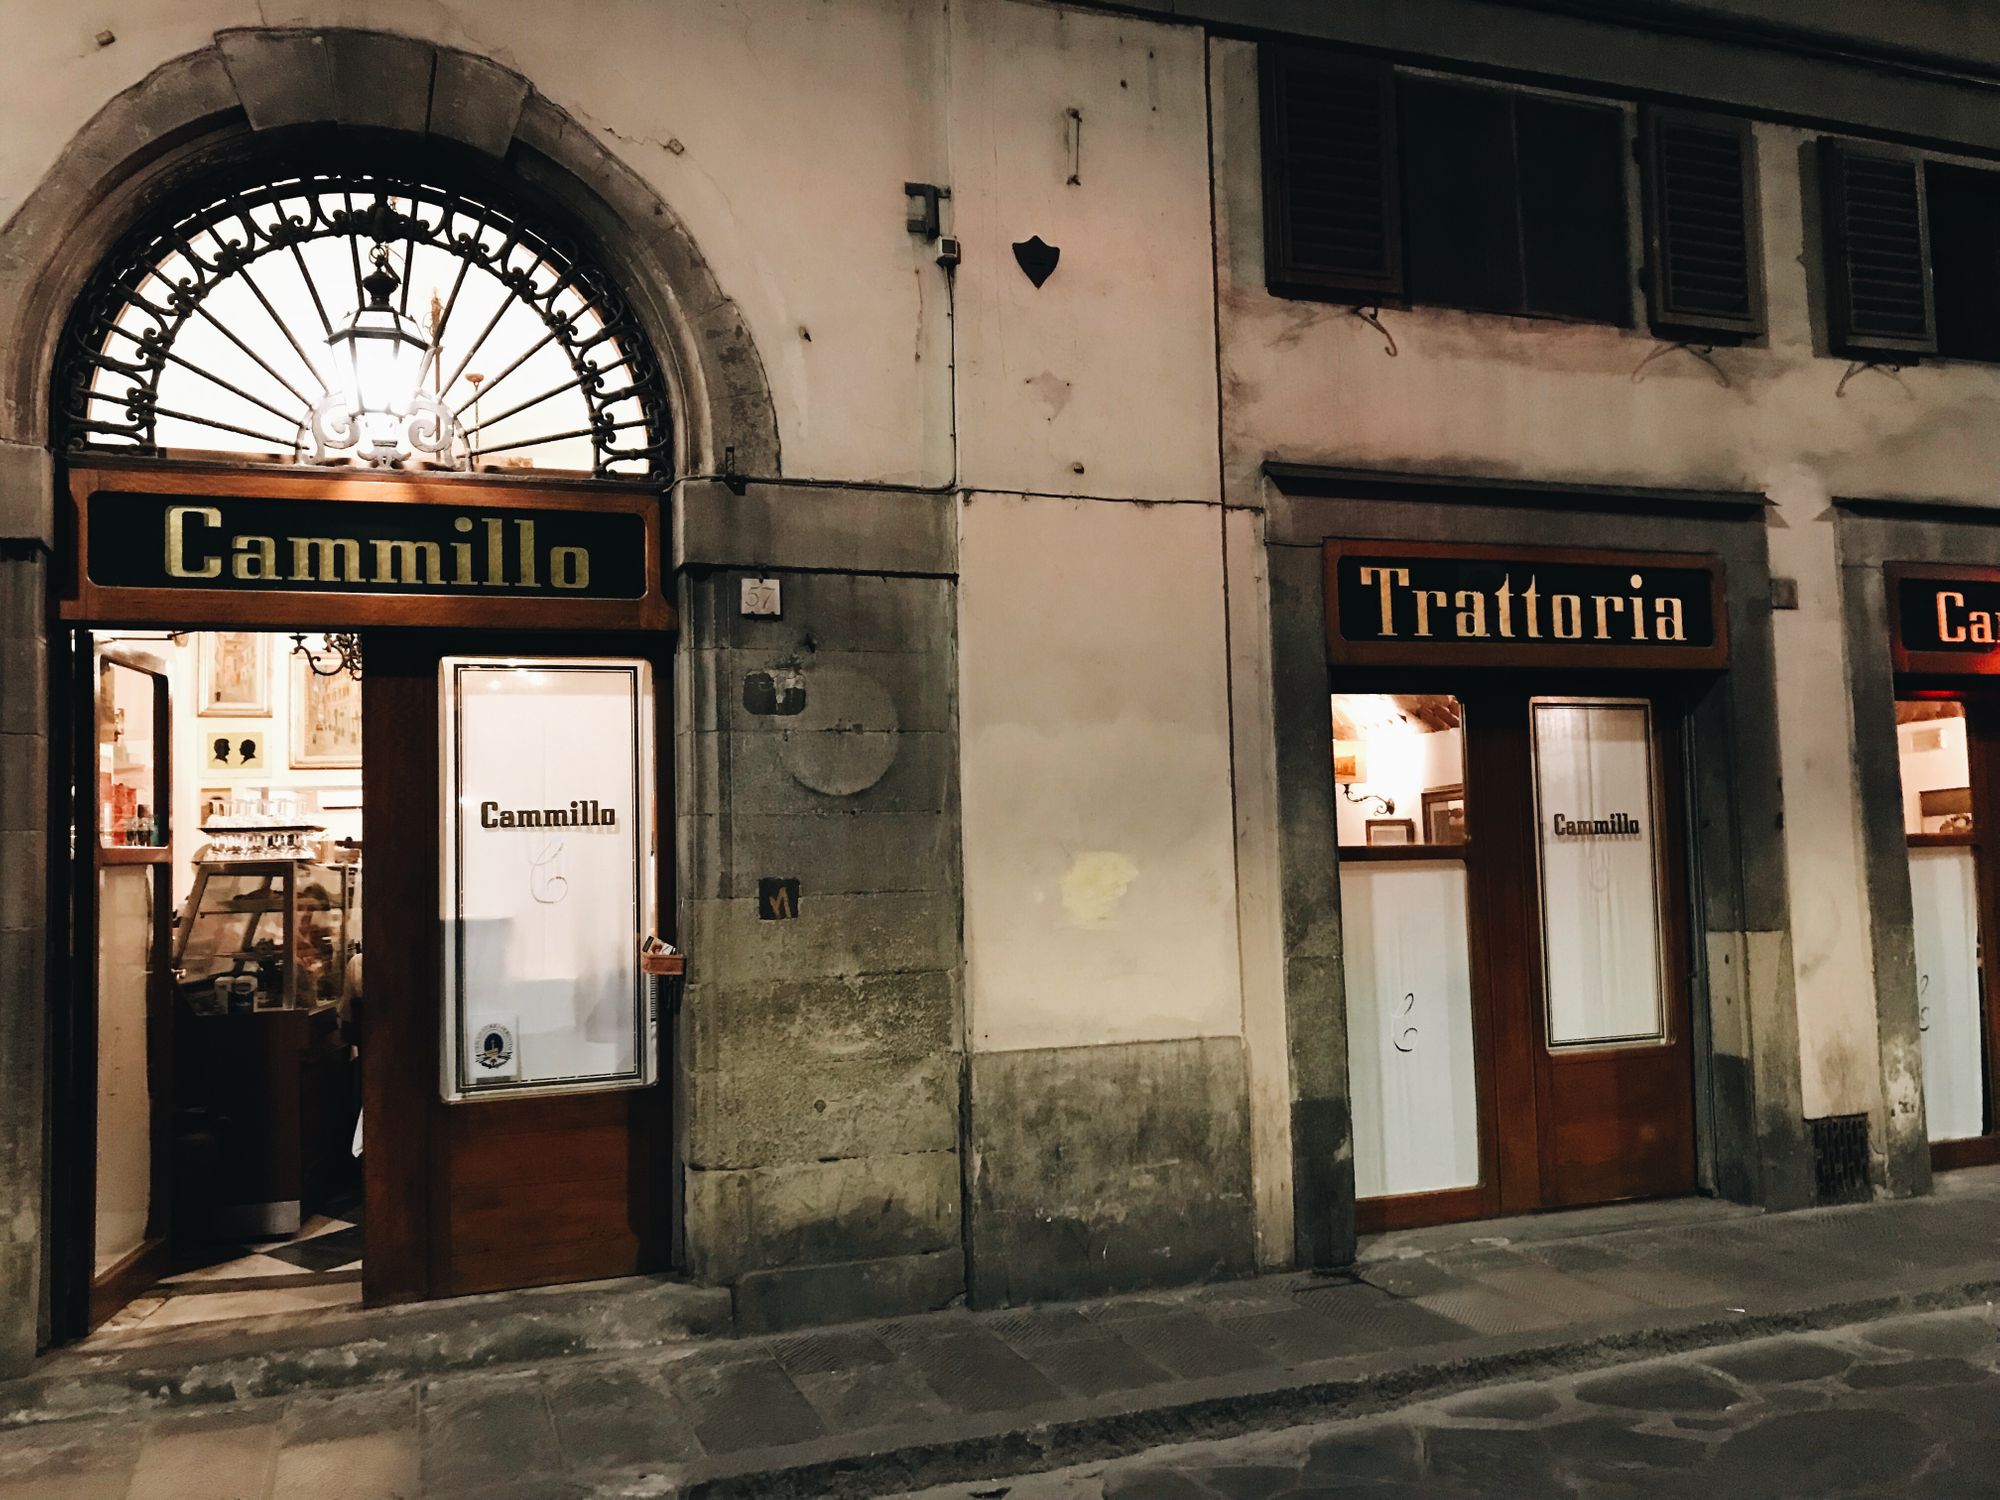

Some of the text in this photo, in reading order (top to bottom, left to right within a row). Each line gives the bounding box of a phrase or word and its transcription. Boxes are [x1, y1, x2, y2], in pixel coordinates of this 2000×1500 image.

[164, 505, 590, 589] Cammillo
[745, 586, 776, 609] 57
[1360, 567, 1687, 641] Trattoria
[1936, 591, 2000, 643] Ca
[481, 800, 615, 828] Cammillo
[1553, 813, 1640, 836] Cammillo
